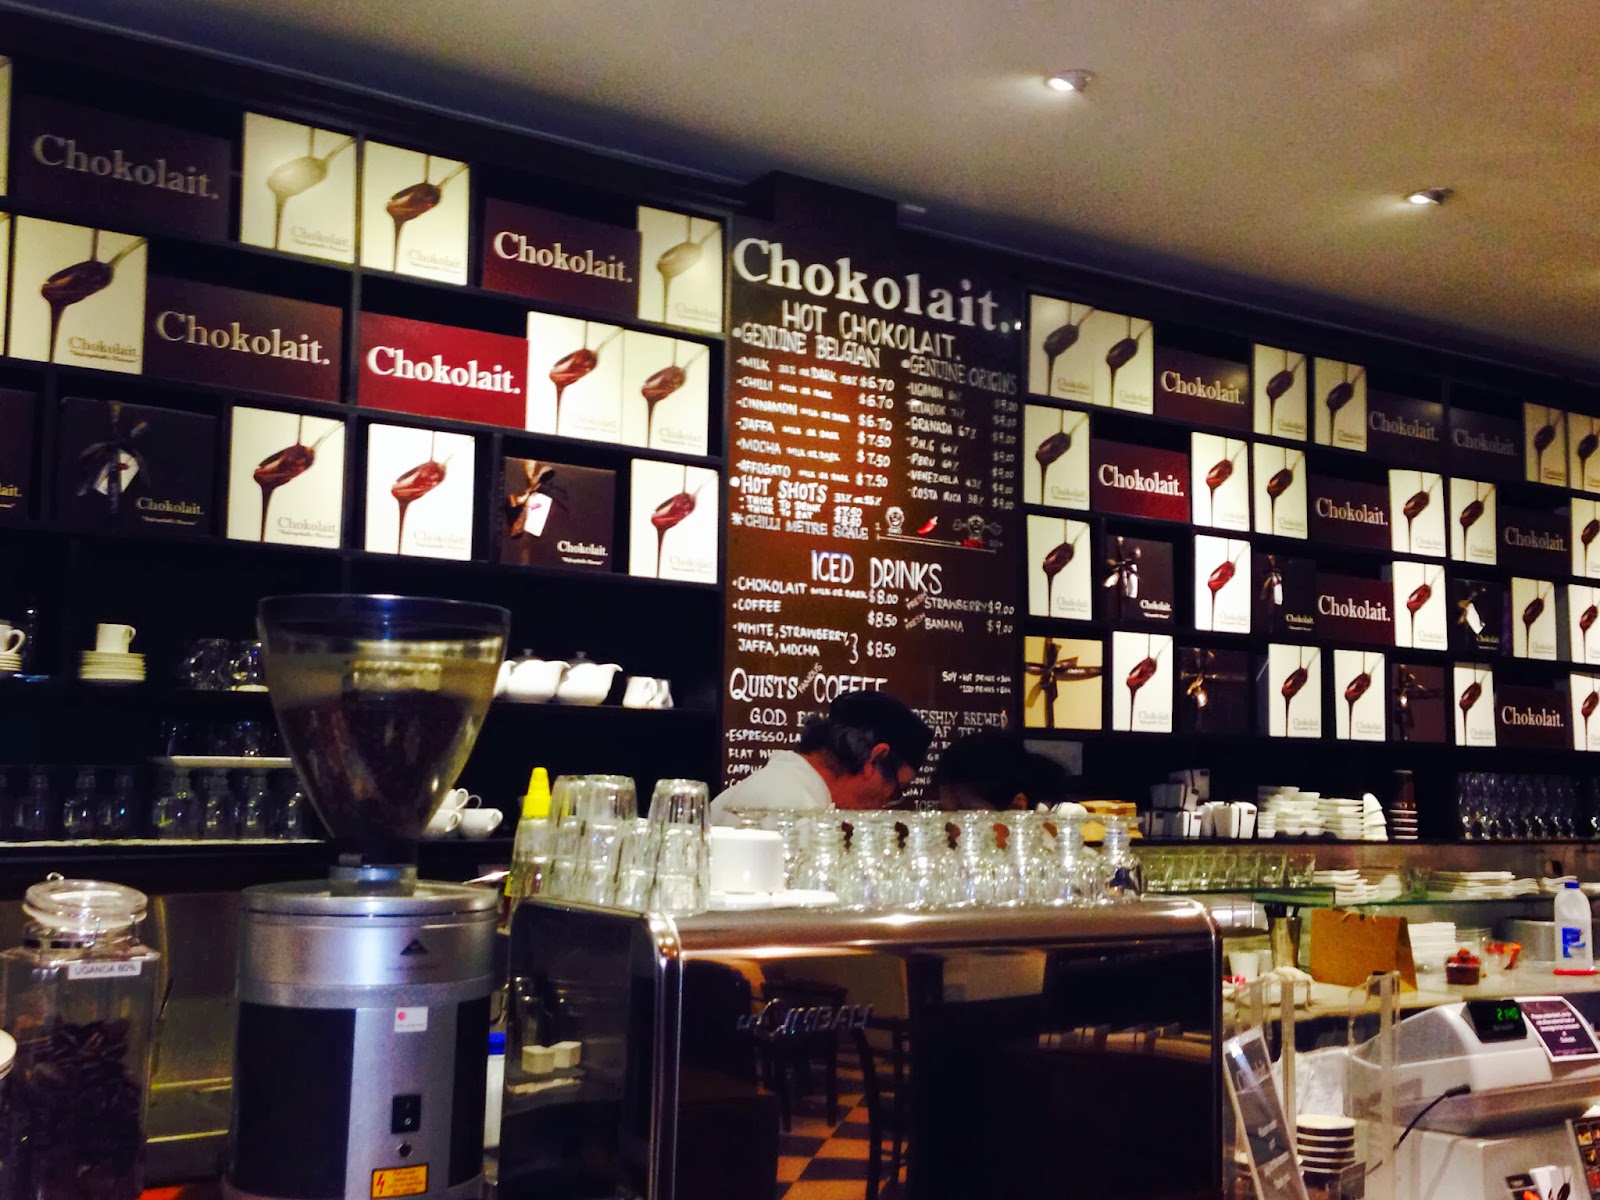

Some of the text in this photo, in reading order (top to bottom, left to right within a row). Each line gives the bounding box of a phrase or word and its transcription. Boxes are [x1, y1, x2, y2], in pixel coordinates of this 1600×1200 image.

[33, 134, 219, 199] Chokolait.
[493, 231, 633, 283] Chokolait.
[733, 238, 1010, 333] Chokolait.
[782, 300, 827, 333] HOT
[156, 311, 330, 365] Chokolait.
[741, 322, 880, 368] GENUINE BELGIAN
[367, 345, 521, 395] Chokolait.
[910, 355, 1017, 394] GENUINE ORIGINS
[1160, 371, 1245, 405] Chokolait.
[1369, 411, 1439, 442] Chokolait.
[1453, 428, 1518, 456] Chokolait.
[741, 474, 772, 495] HOT
[778, 480, 828, 503] SHOTS
[1098, 464, 1184, 497] Chokolait.
[1316, 497, 1388, 526] Chokolait.
[744, 514, 781, 531] CHILLI
[786, 520, 828, 536] METRE
[832, 524, 869, 540] SCALE
[1504, 527, 1567, 552] Chokolait.
[557, 540, 608, 556] Chokolait.
[811, 550, 942, 595] ICED DRINKS
[737, 576, 807, 595] CHOKOLAIT
[868, 588, 898, 605] $8.00
[924, 597, 987, 612] STRAWBERRY
[737, 598, 897, 628] COFFEE $8.50
[1318, 595, 1391, 622] Chokolait.
[925, 617, 964, 633] BANANA
[866, 640, 896, 658] $8.50
[729, 667, 798, 702] QUISTS
[1502, 706, 1564, 728] Chokolait.
[728, 748, 753, 759] FLAT
[74, 965, 116, 976] UGANDA
